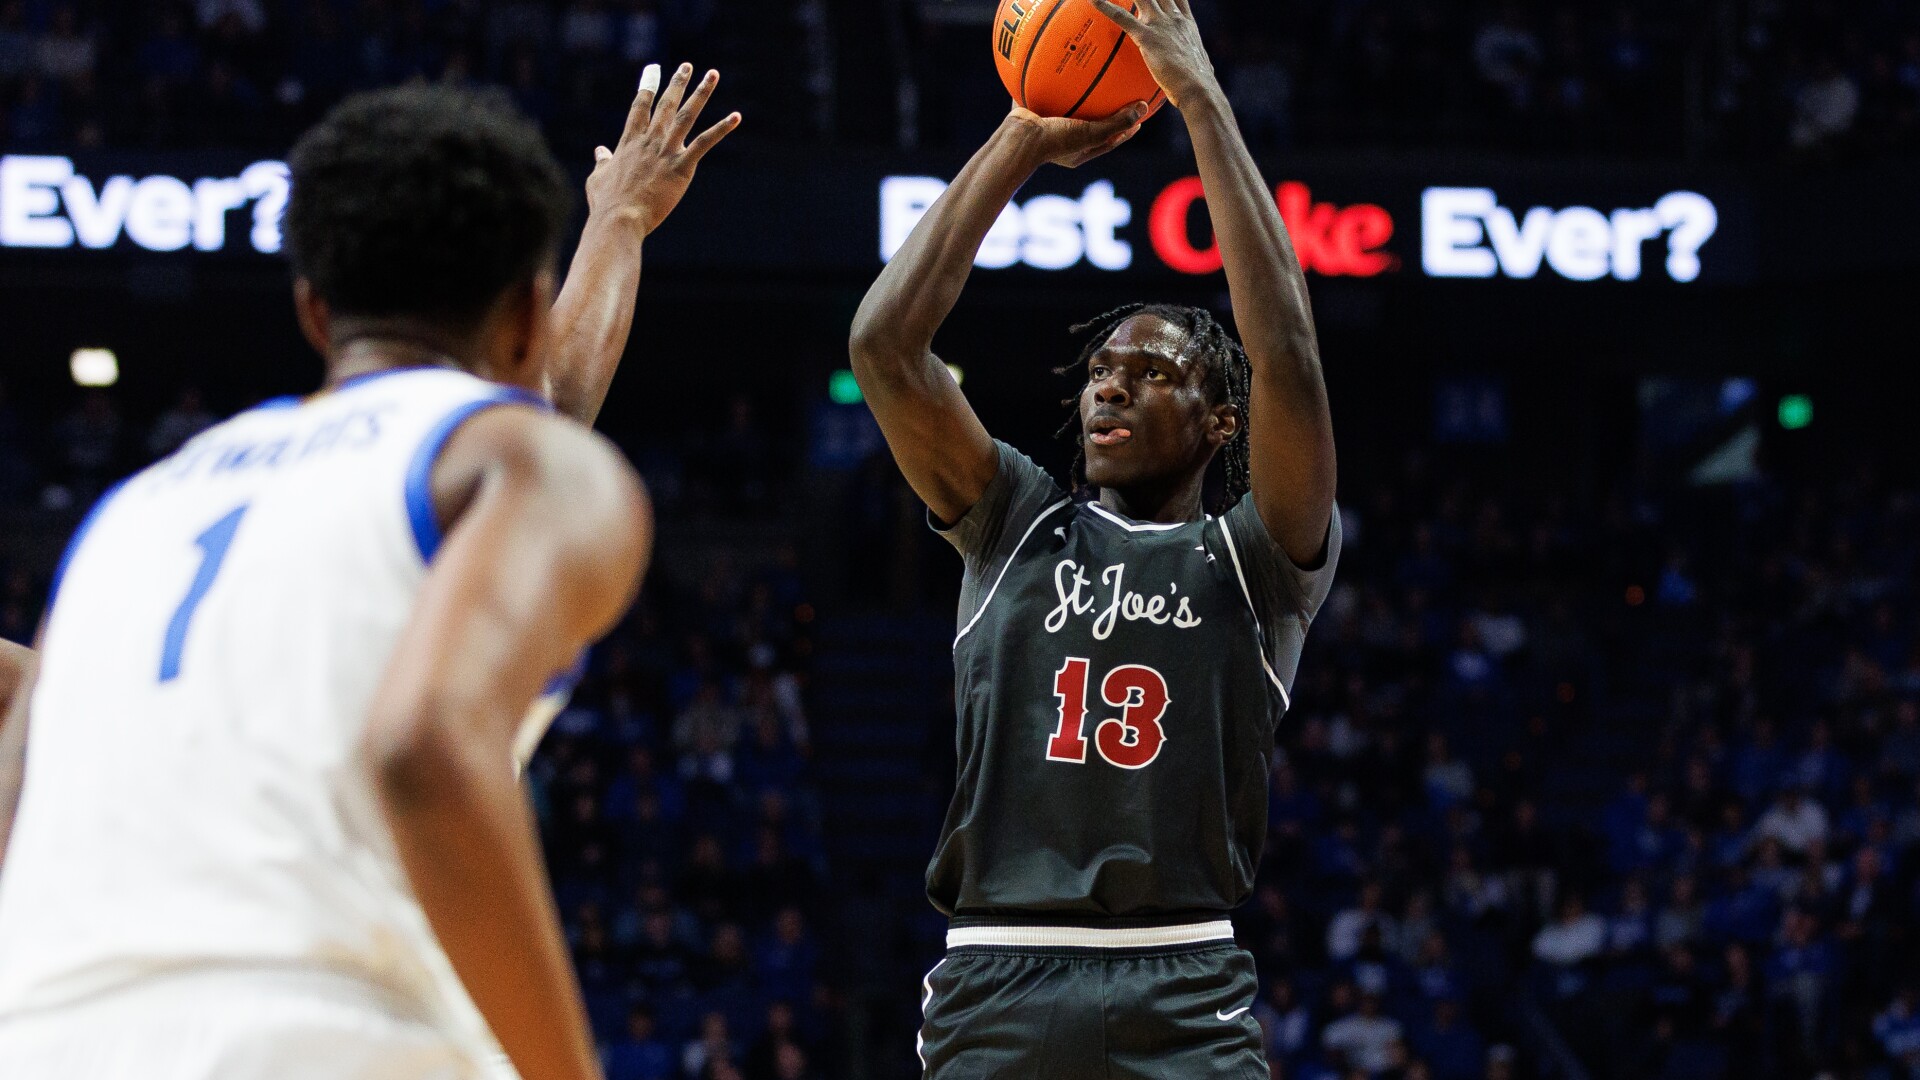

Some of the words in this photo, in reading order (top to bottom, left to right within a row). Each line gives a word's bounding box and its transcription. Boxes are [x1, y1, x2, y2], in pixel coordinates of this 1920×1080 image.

[998, 0, 1026, 61] ELI
[0, 154, 292, 253] Ever?
[1421, 186, 1718, 282] Ever?
[157, 497, 252, 684] 1
[1044, 559, 1096, 633] St.
[1092, 562, 1202, 641] Joe's
[1045, 656, 1173, 770] 13
